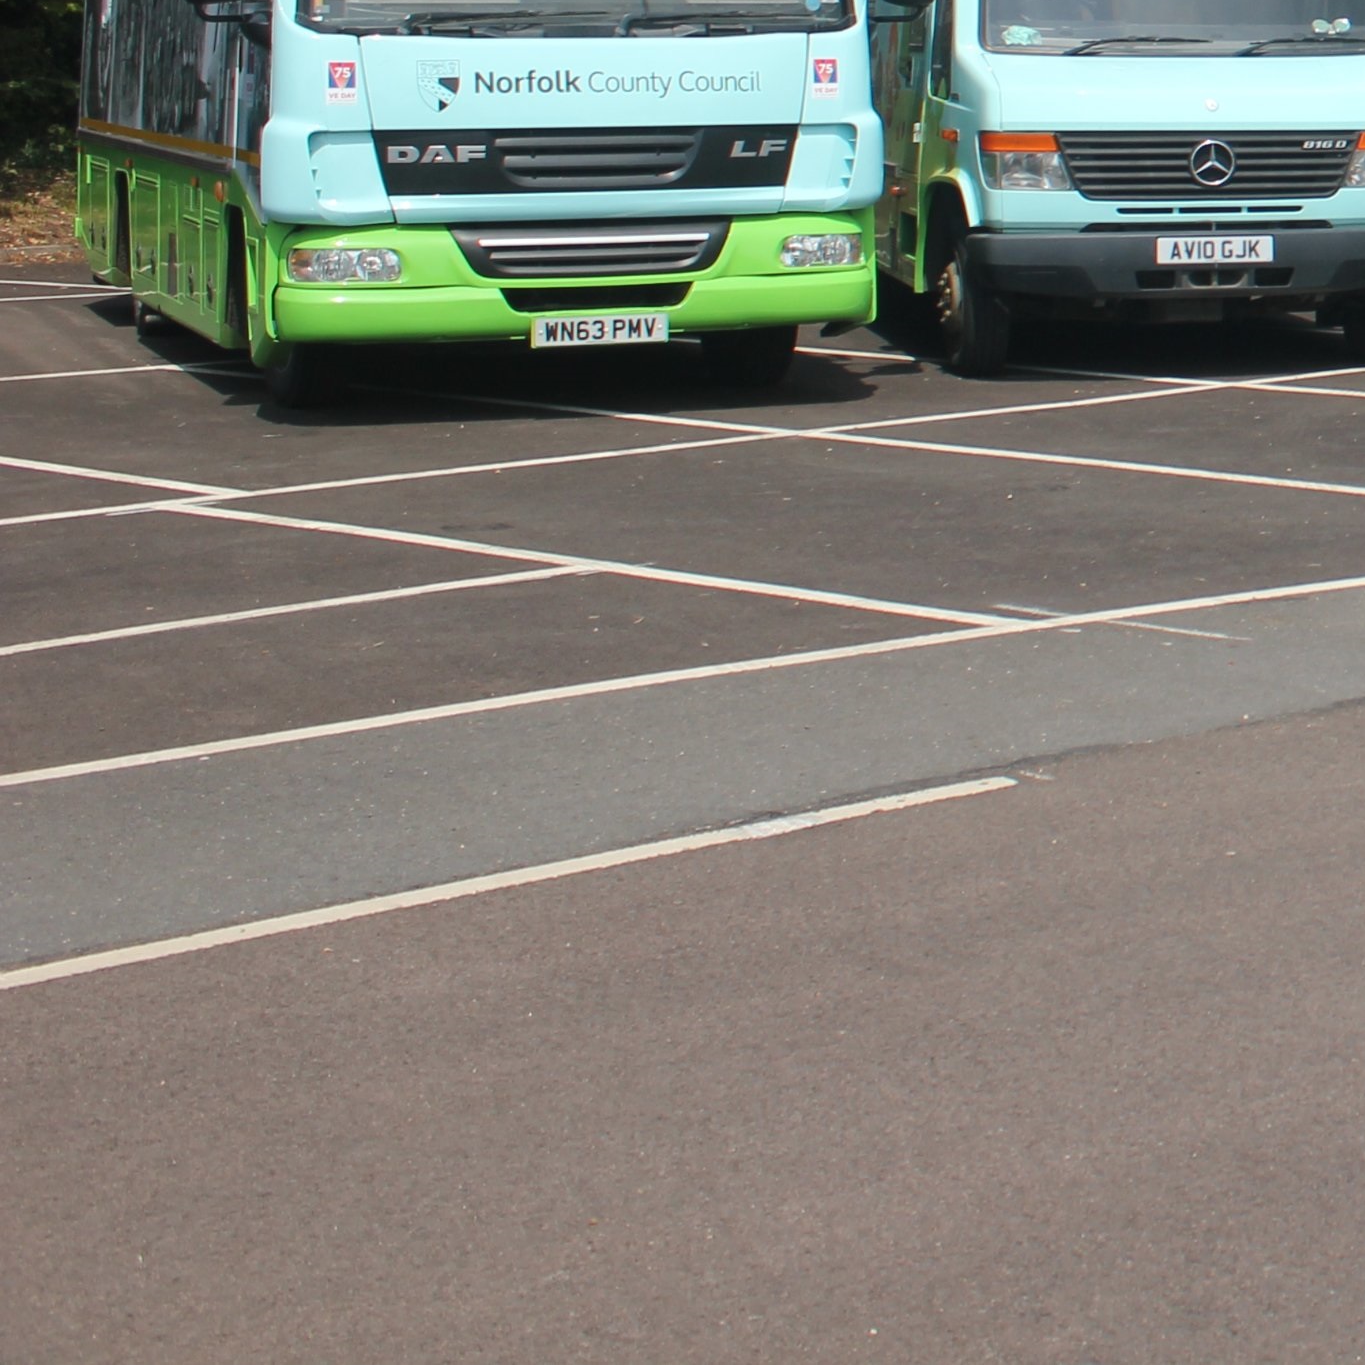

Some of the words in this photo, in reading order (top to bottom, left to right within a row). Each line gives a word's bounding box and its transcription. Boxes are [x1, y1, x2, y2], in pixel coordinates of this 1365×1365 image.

[334, 66, 352, 79] 75
[818, 63, 833, 74] 75
[473, 70, 581, 94] Norfolk
[588, 71, 672, 98] County
[679, 70, 761, 93] Council
[387, 144, 487, 164] DAF
[730, 138, 788, 159] LF
[1170, 240, 1216, 260] AV10
[1221, 239, 1260, 259] GJK
[545, 320, 606, 342] WN63
[612, 317, 656, 340] PMV
